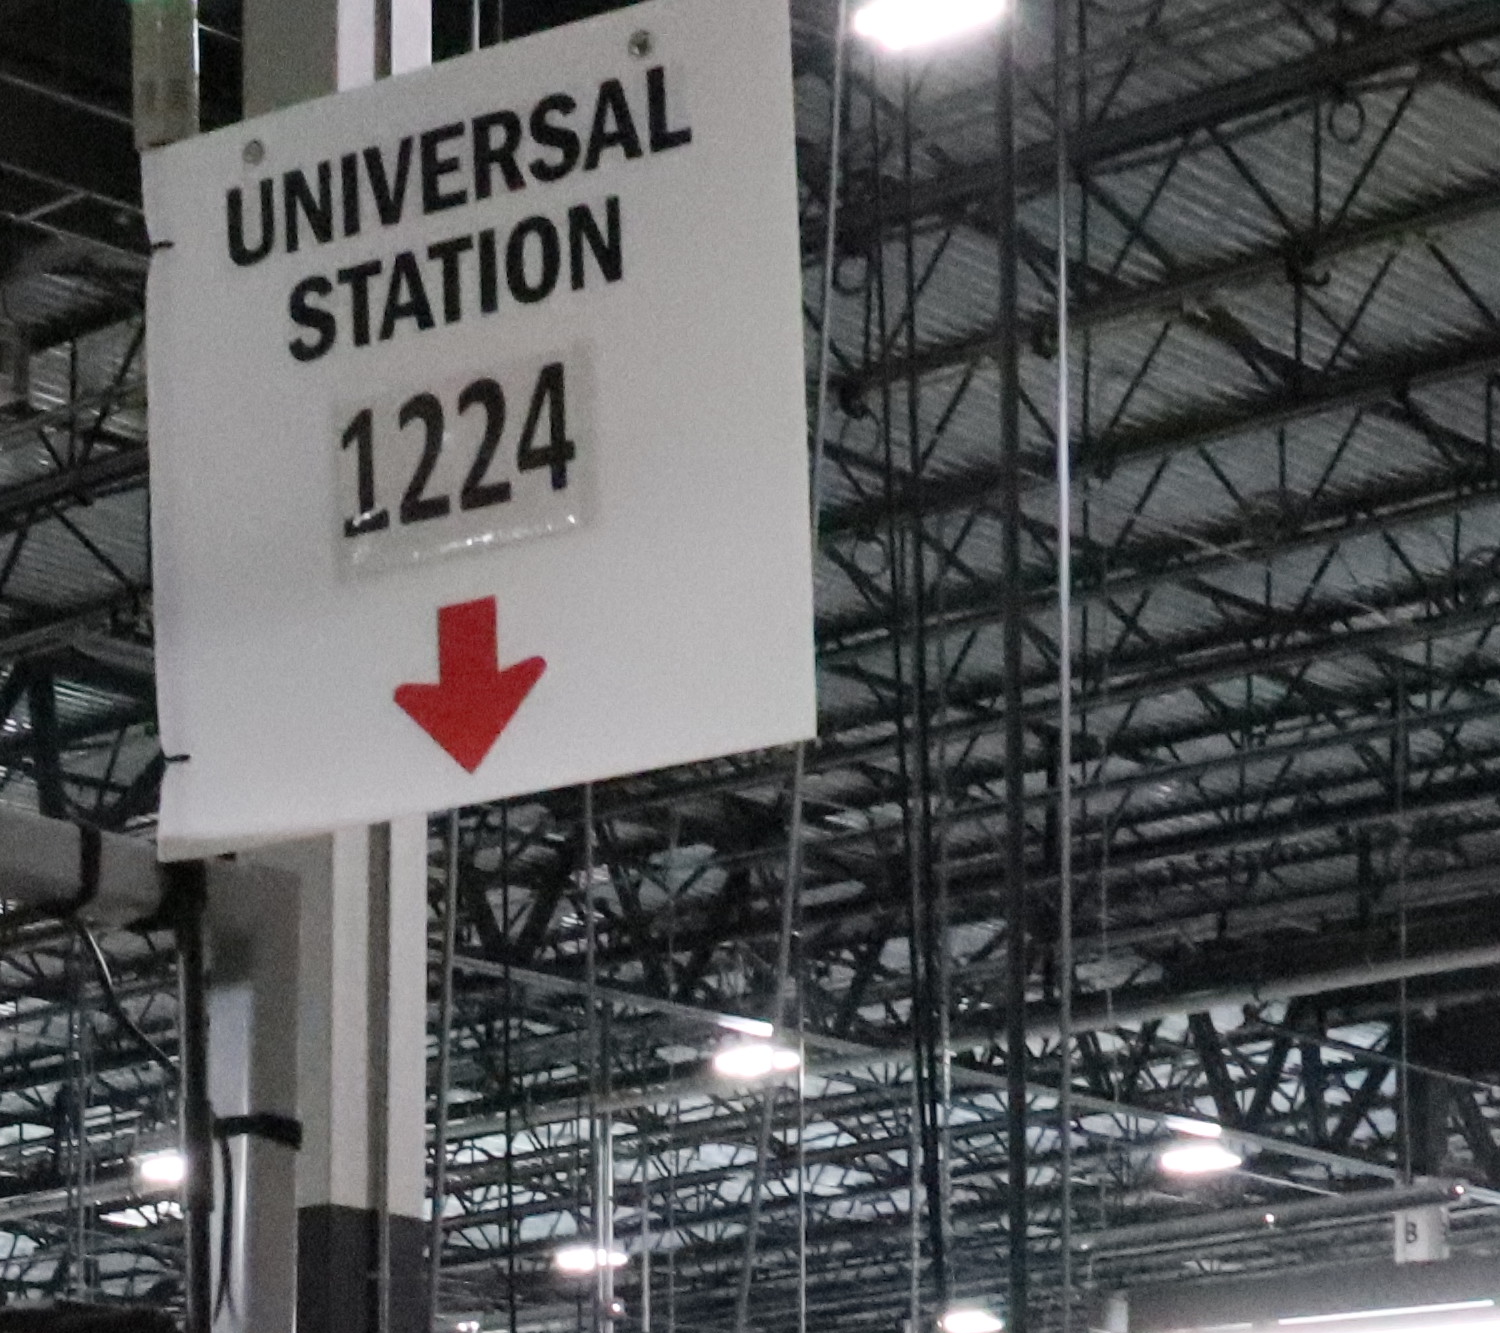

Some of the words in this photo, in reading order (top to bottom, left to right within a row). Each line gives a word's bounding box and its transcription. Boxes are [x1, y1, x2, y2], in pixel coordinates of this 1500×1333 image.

[225, 65, 692, 268] UNIVERSAL
[287, 197, 625, 363] STATION
[341, 361, 577, 540] 1224
